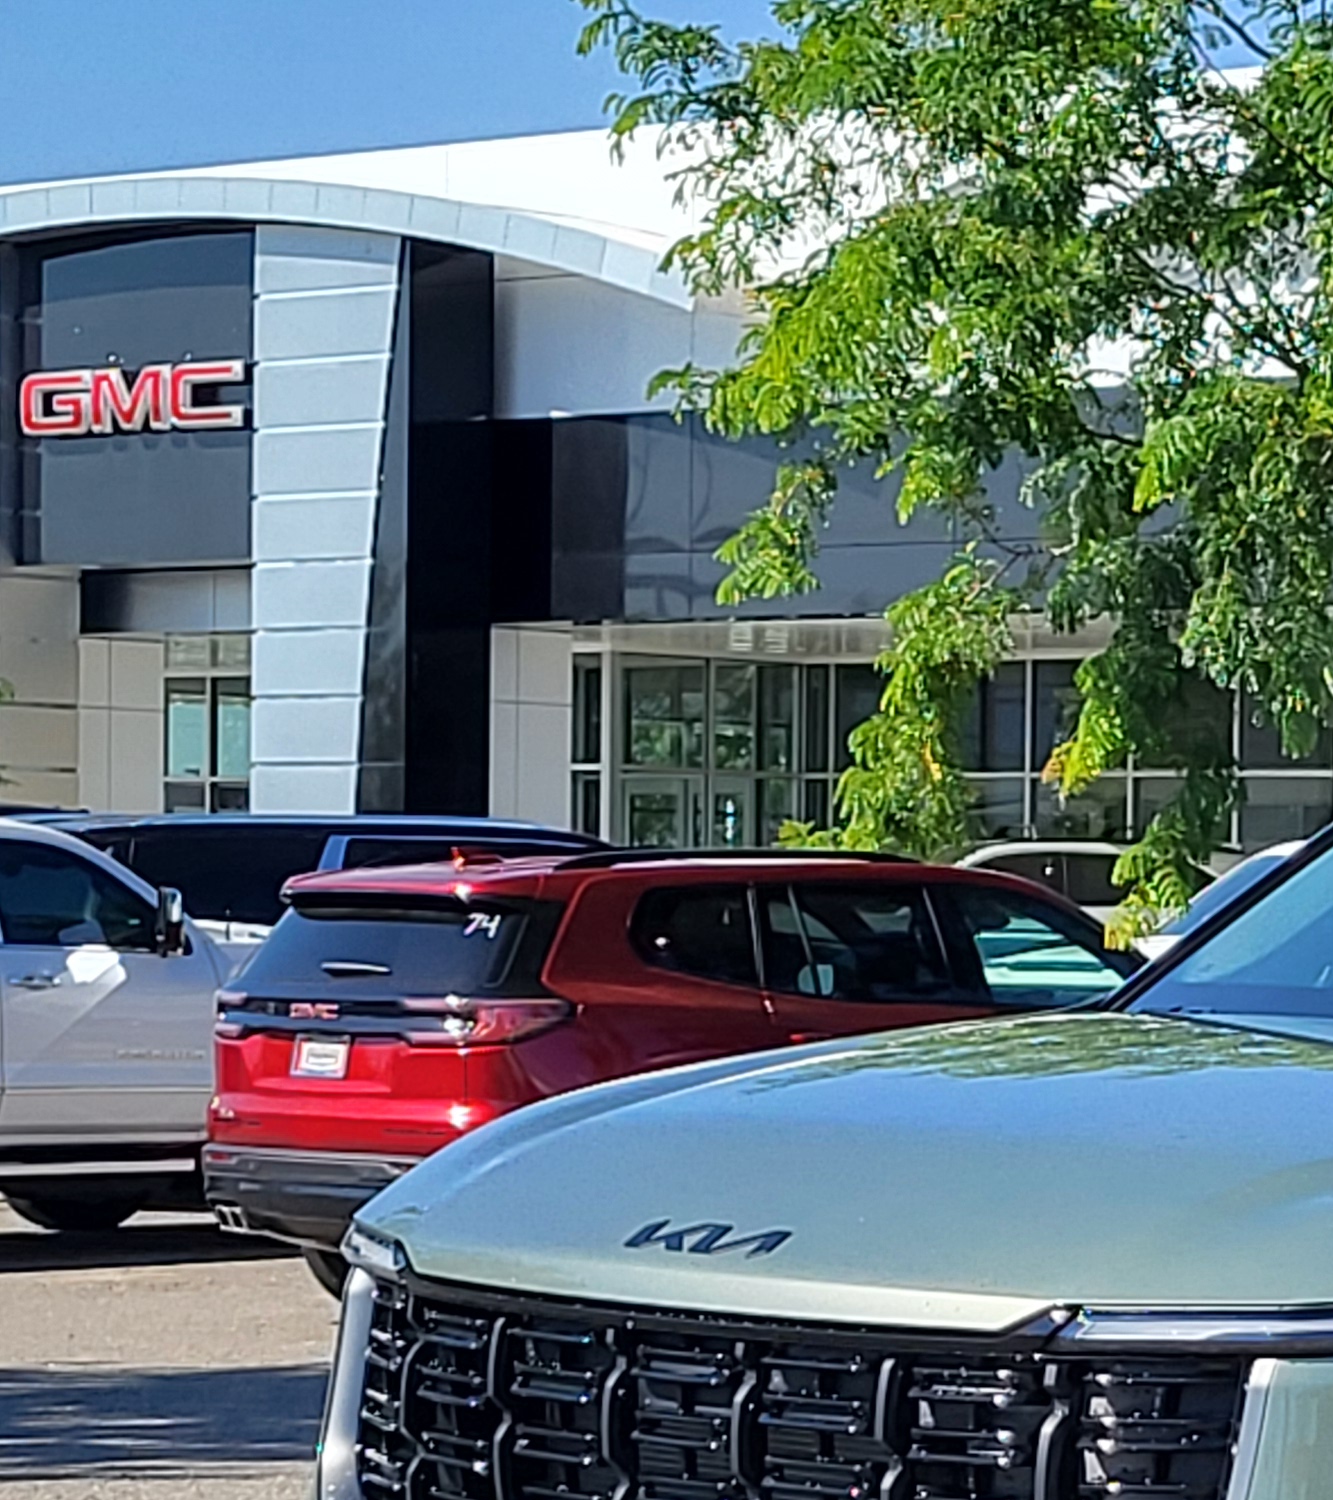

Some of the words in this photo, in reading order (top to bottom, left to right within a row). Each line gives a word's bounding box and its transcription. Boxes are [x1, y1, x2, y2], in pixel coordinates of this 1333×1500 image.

[20, 359, 245, 437] GMC
[463, 912, 501, 938] 74
[624, 1219, 793, 1259] KIA
